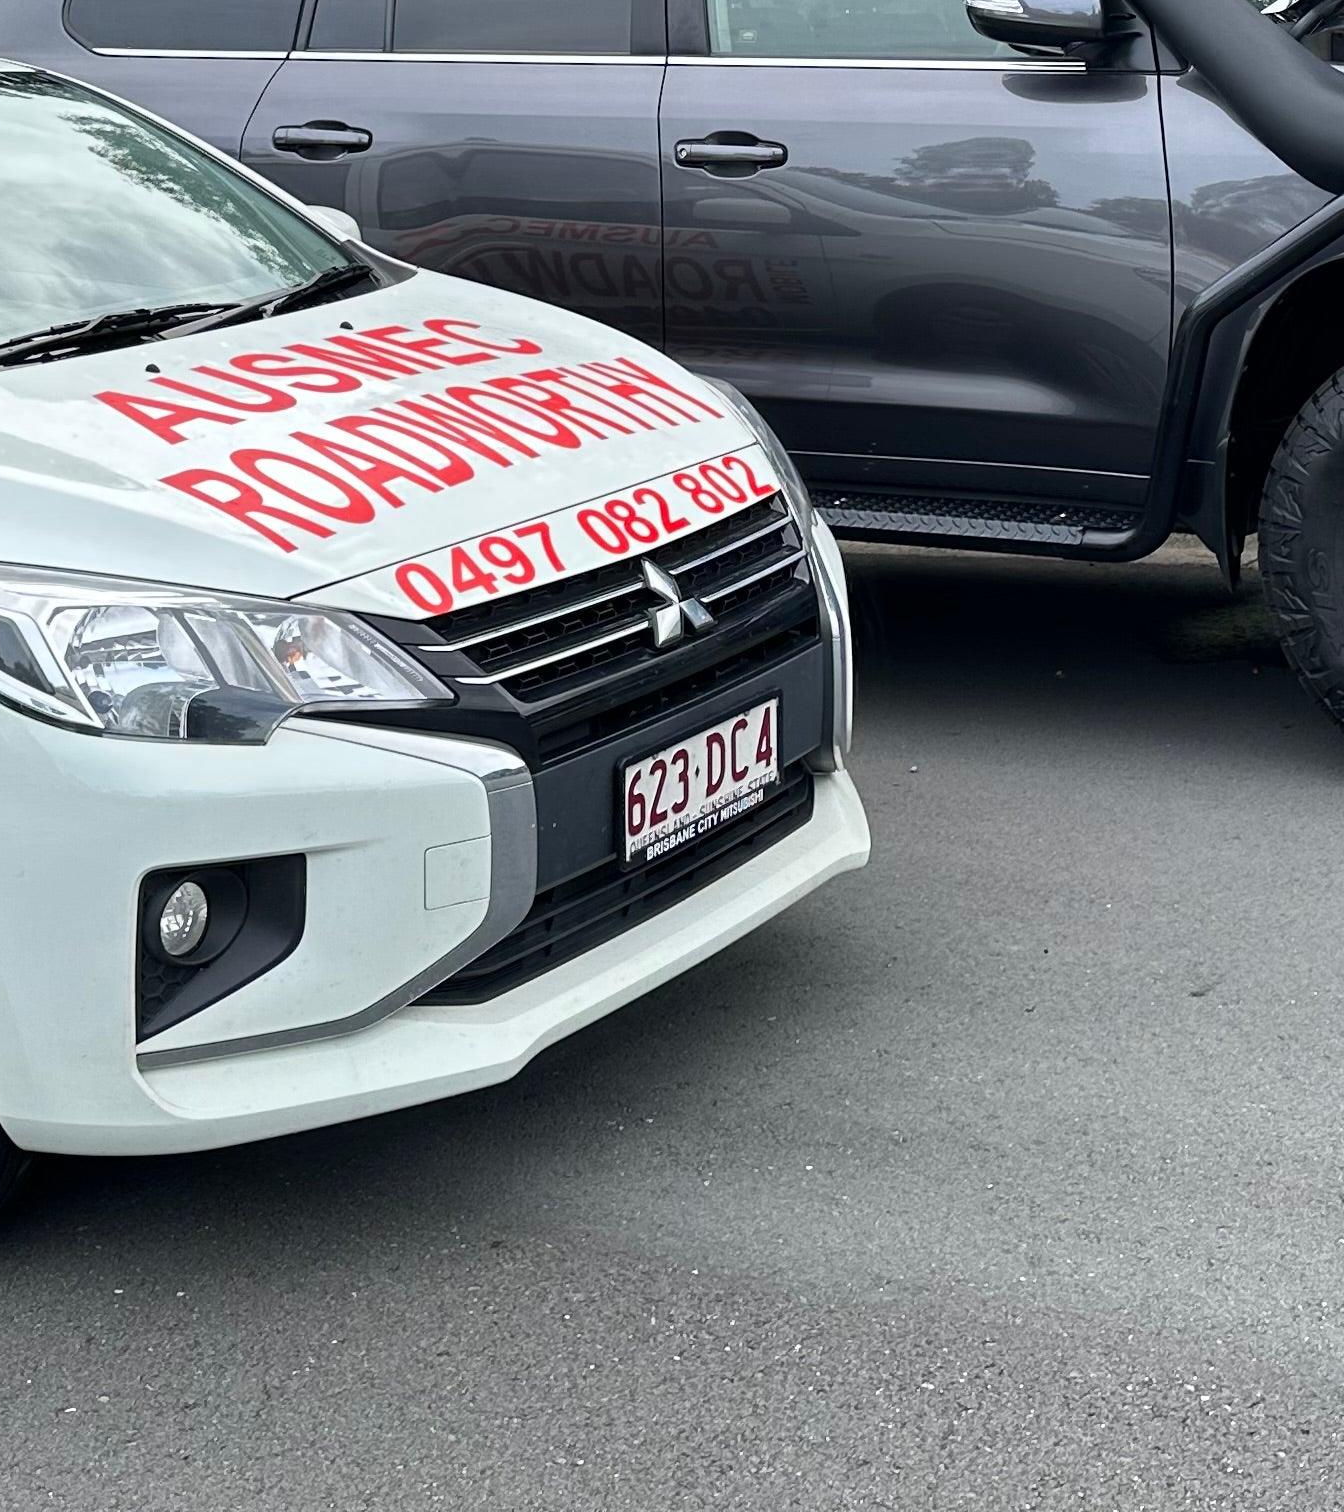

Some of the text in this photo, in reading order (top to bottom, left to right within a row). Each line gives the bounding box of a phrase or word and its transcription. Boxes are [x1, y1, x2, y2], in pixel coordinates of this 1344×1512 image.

[94, 318, 543, 445] AUSMEC
[158, 356, 723, 553] ROADWORTHY
[394, 456, 776, 615] 0497 082 802
[629, 813, 691, 854] QUEENSLAND
[699, 785, 744, 815] SUNSHINE
[748, 770, 775, 791] STATE
[646, 787, 765, 861] BRISBANE CITY MITSUBISHI
